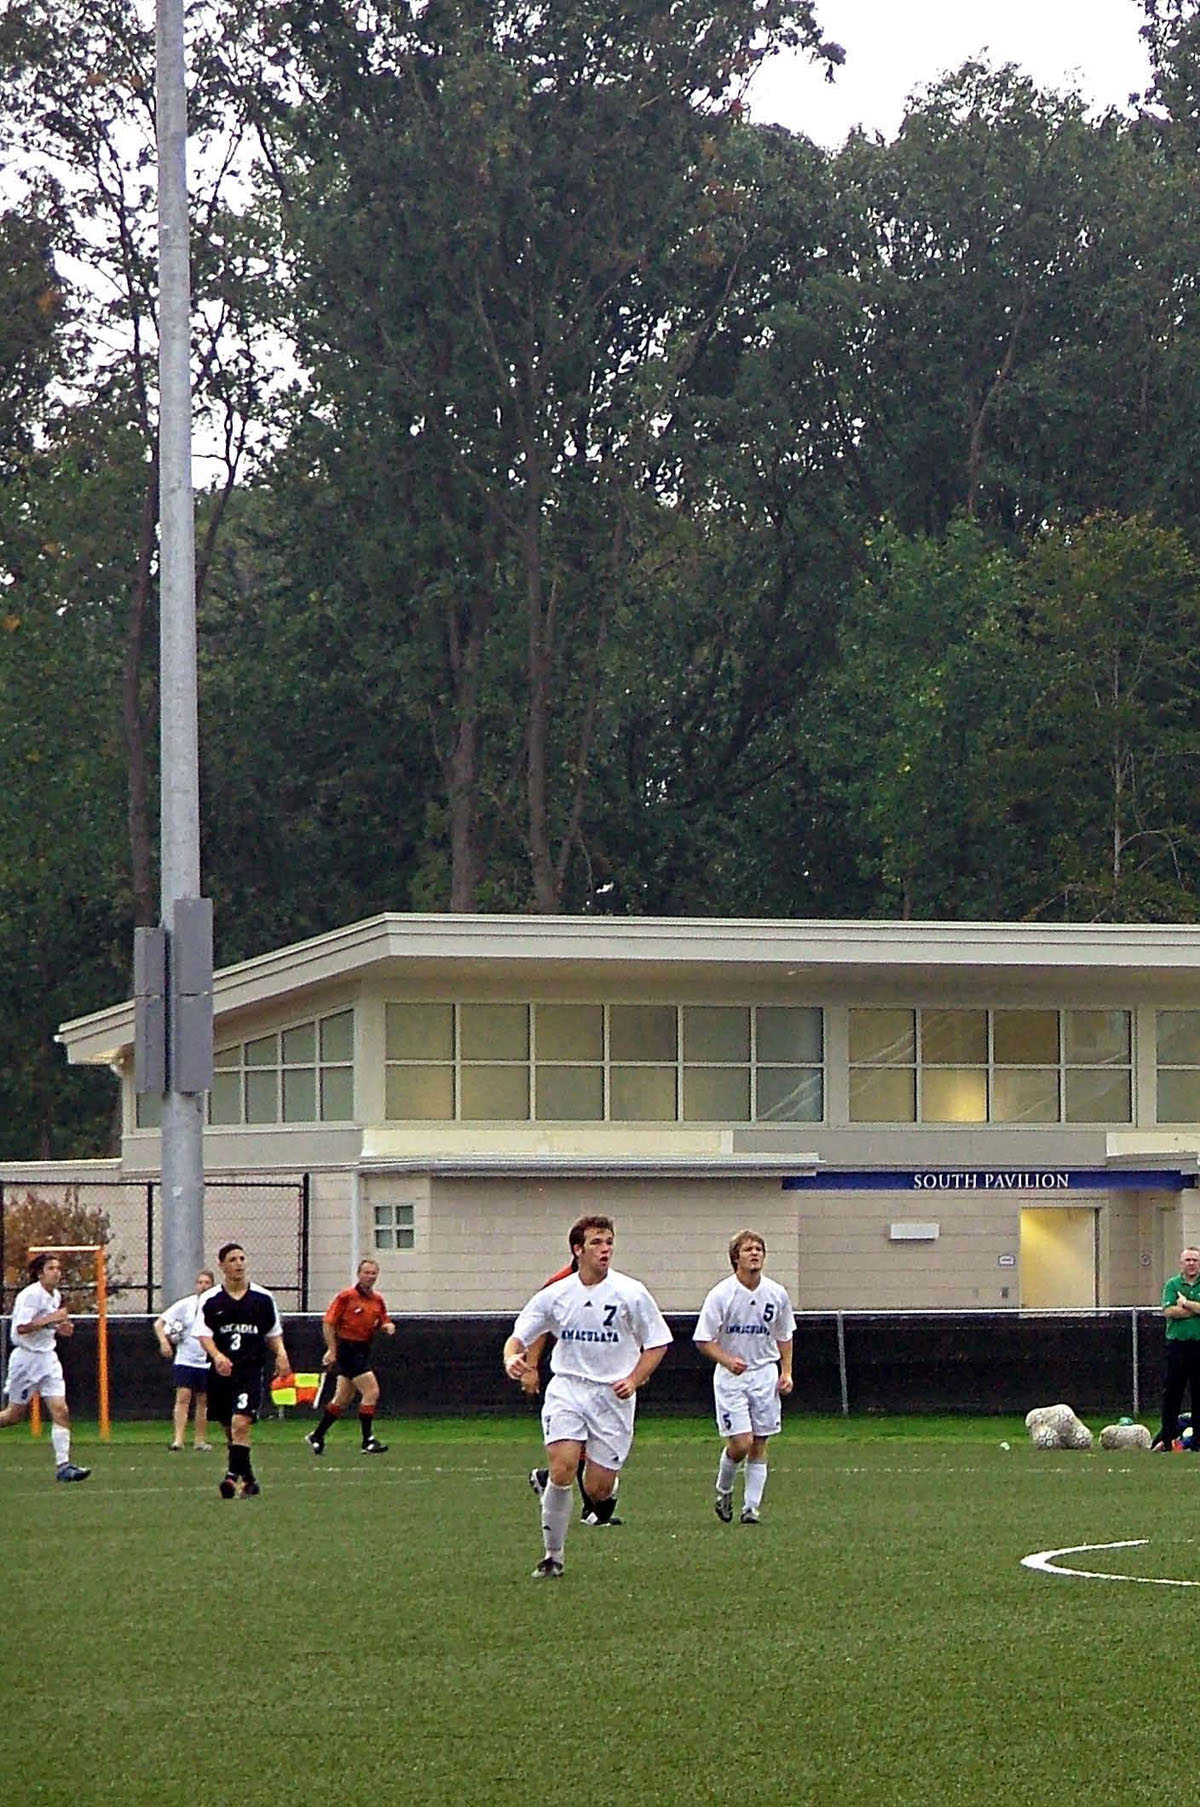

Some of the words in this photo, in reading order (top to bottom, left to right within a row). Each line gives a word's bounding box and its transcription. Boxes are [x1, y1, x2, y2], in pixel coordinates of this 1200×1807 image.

[913, 1173, 977, 1190] SOUTH
[985, 1173, 1070, 1190] PAVILION
[603, 1304, 617, 1327] 7
[763, 1302, 775, 1322] 5
[230, 1333, 242, 1351] 3
[237, 1393, 248, 1410] 3
[722, 1413, 732, 1431] 5
